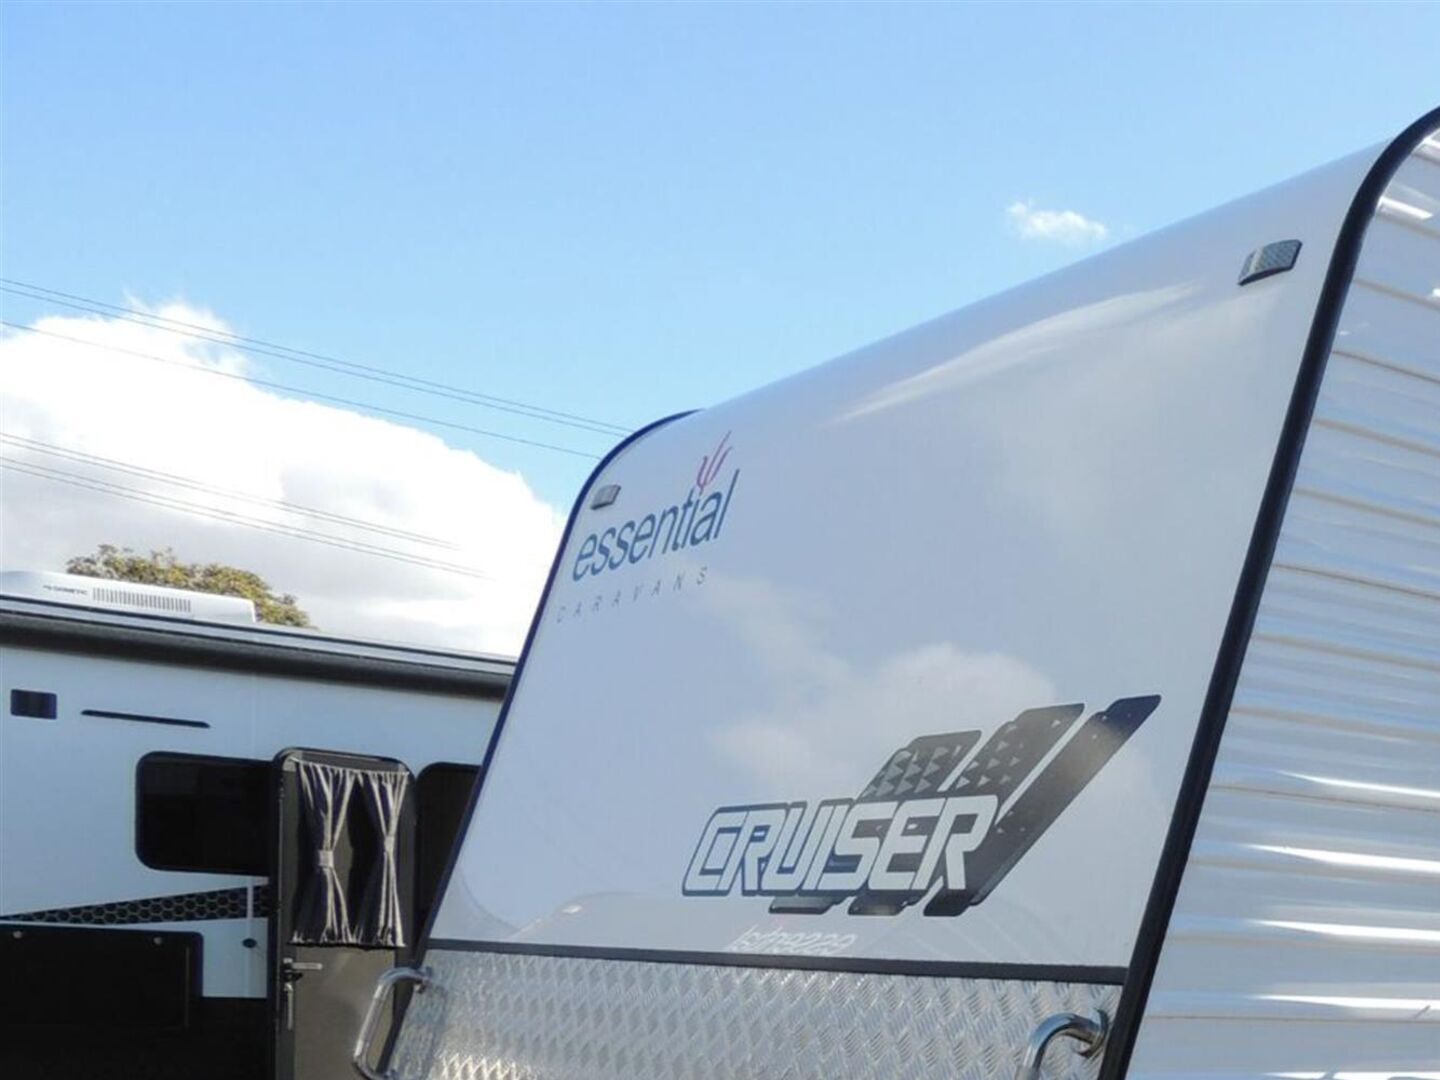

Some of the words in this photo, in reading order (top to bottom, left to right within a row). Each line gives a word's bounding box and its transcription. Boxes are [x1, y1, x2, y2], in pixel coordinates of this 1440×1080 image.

[572, 468, 740, 581] essential
[557, 566, 707, 623] CARAVANS
[682, 795, 1000, 897] CRUISER
